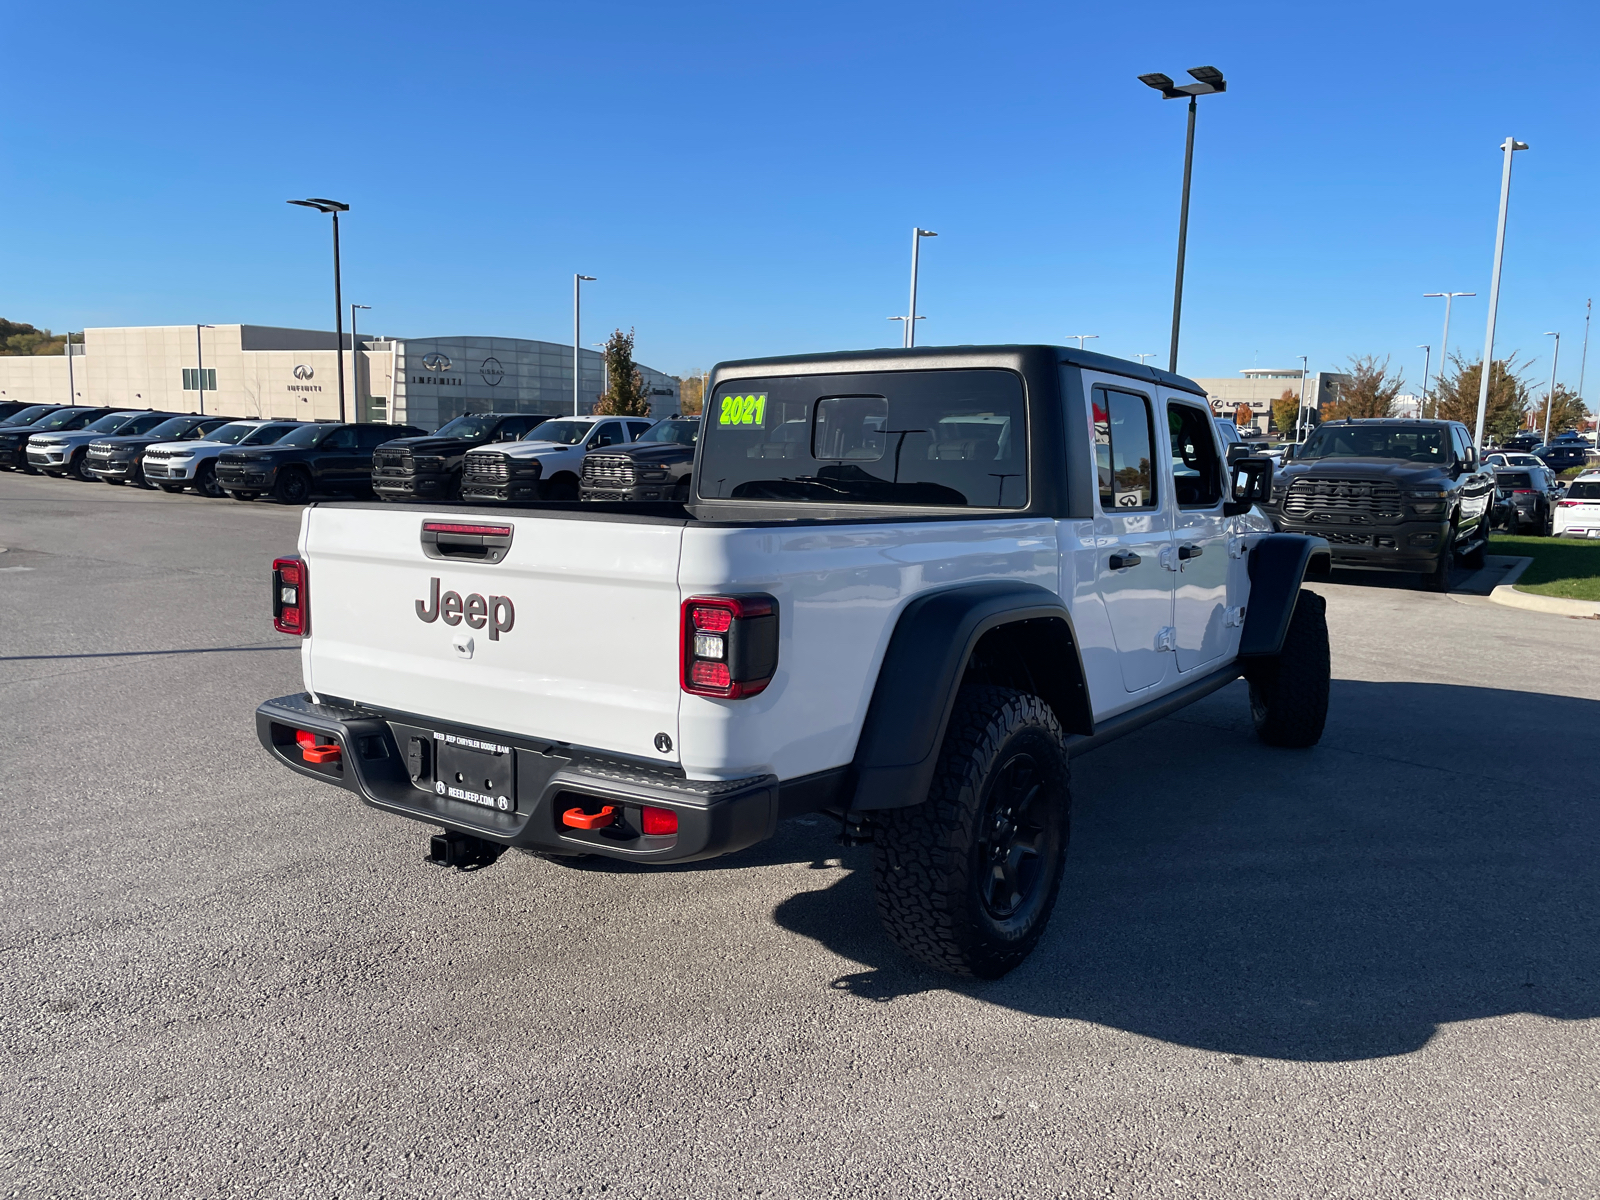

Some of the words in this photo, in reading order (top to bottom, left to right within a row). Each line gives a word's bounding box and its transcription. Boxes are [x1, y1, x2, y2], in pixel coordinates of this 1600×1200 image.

[412, 376, 462, 386] INFINITI
[479, 368, 505, 376] NISSAN
[719, 395, 766, 426] 2021
[415, 577, 515, 642] Jeep
[433, 732, 445, 741] REED
[445, 734, 456, 743] JEEP
[456, 736, 480, 749] CHRYSLER
[480, 742, 497, 752] DODGE
[497, 745, 510, 754] RAM
[448, 786, 494, 807] REEDJEEP.COM
